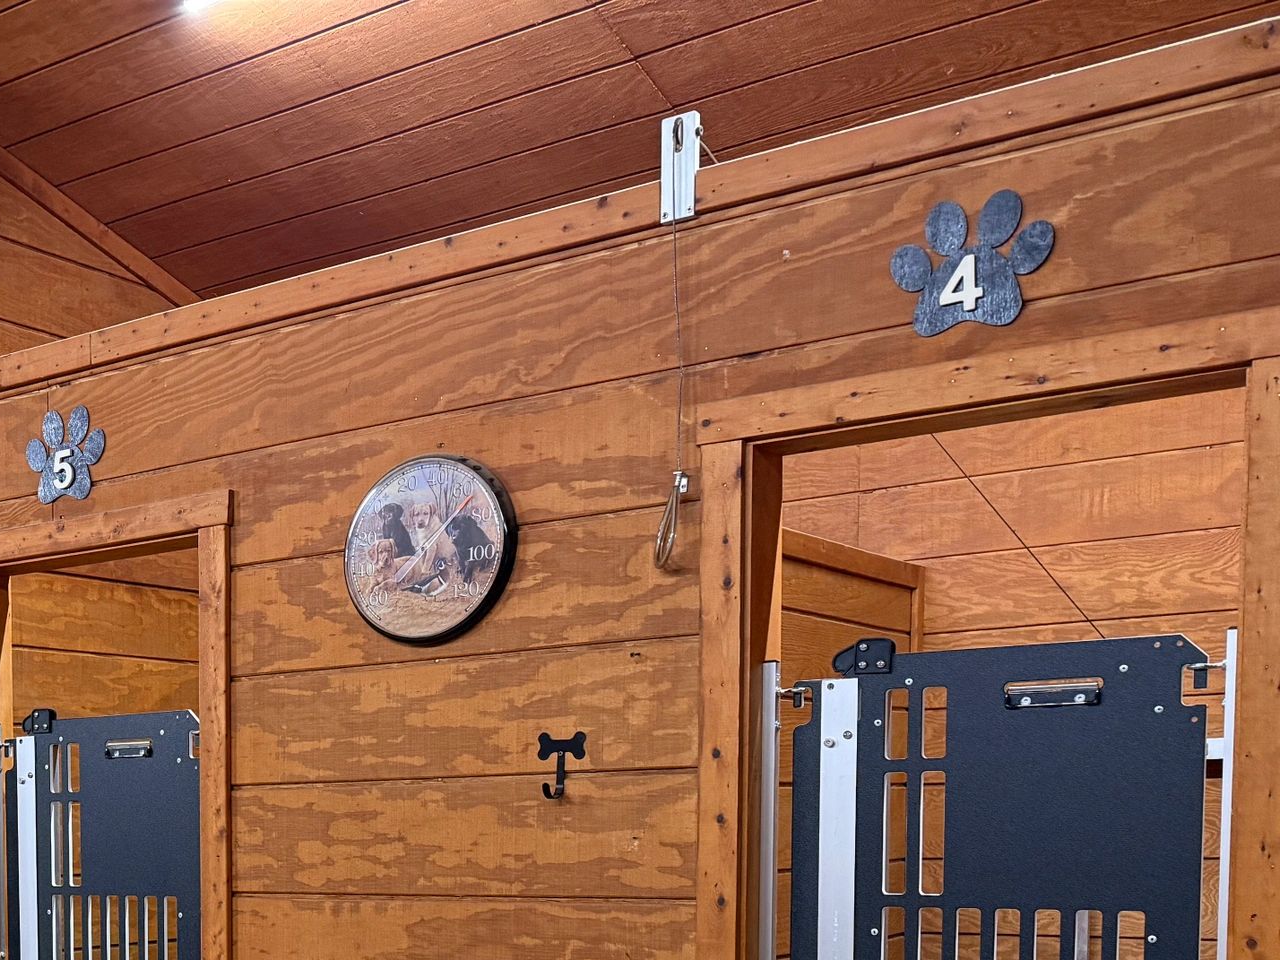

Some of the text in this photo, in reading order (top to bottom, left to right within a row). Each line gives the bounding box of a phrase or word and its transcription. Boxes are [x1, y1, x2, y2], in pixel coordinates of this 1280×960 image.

[939, 254, 983, 311] 4
[53, 449, 73, 489] 5
[427, 469, 448, 487] 40
[397, 475, 418, 493] 20
[453, 480, 473, 498] 60
[472, 507, 492, 522] 80
[357, 531, 377, 547] 20
[467, 543, 495, 562] 100
[369, 590, 388, 606] 60
[452, 581, 480, 598] 120
